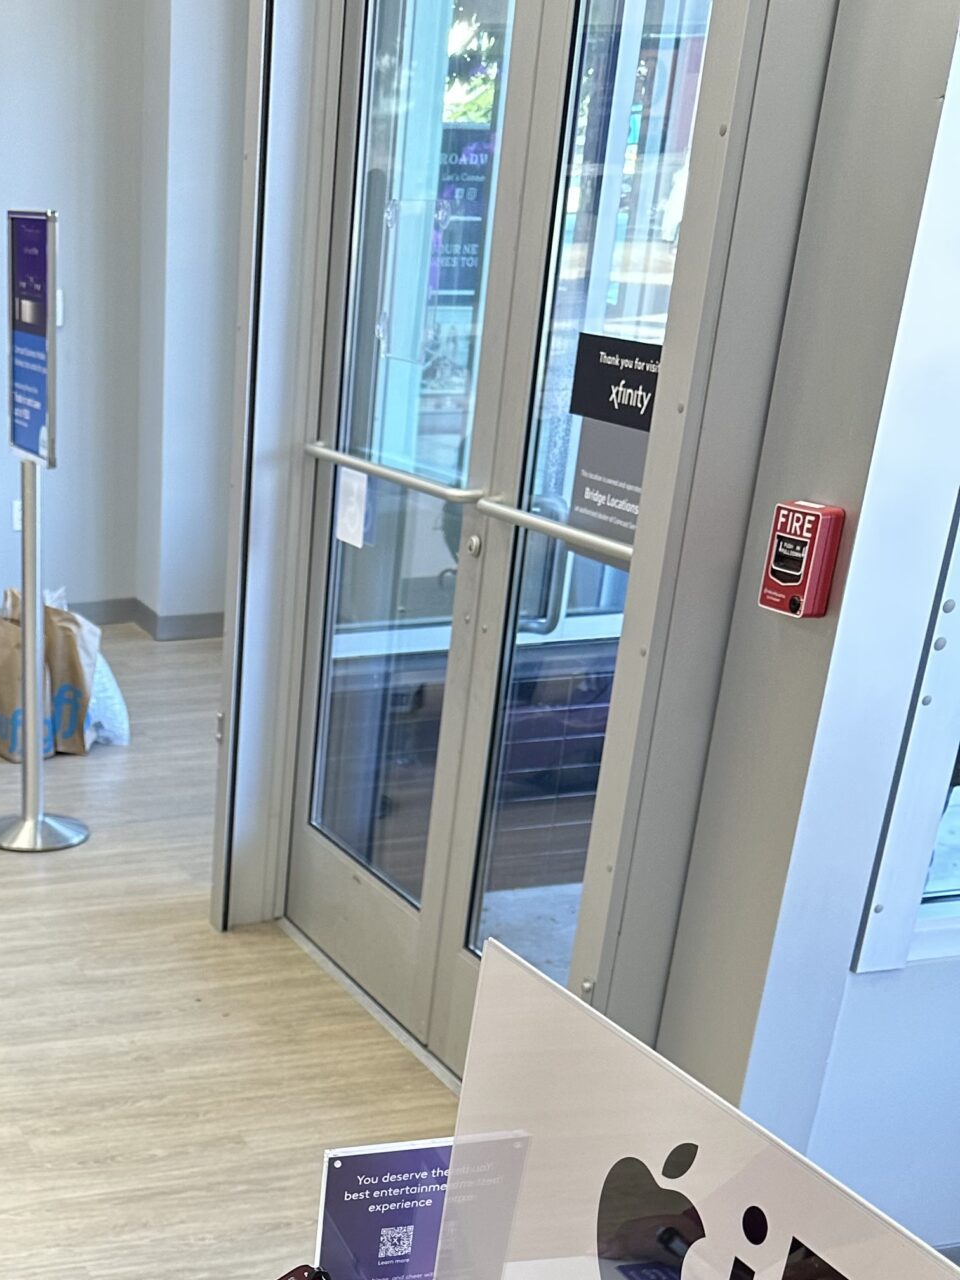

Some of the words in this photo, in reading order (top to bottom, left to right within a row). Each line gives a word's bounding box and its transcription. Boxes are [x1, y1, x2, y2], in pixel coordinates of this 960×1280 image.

[599, 351, 620, 366] Thank
[620, 358, 634, 370] you
[634, 358, 646, 371] for
[609, 379, 651, 415] xfinity
[584, 486, 606, 507] Bridge
[606, 493, 639, 515] Locations
[777, 509, 816, 538] FIRE
[357, 1173, 379, 1186] You
[382, 1169, 428, 1183] deserve
[431, 1166, 449, 1178] the
[344, 1185, 370, 1201] best
[373, 1181, 448, 1199] entertainme
[368, 1197, 433, 1213] experience
